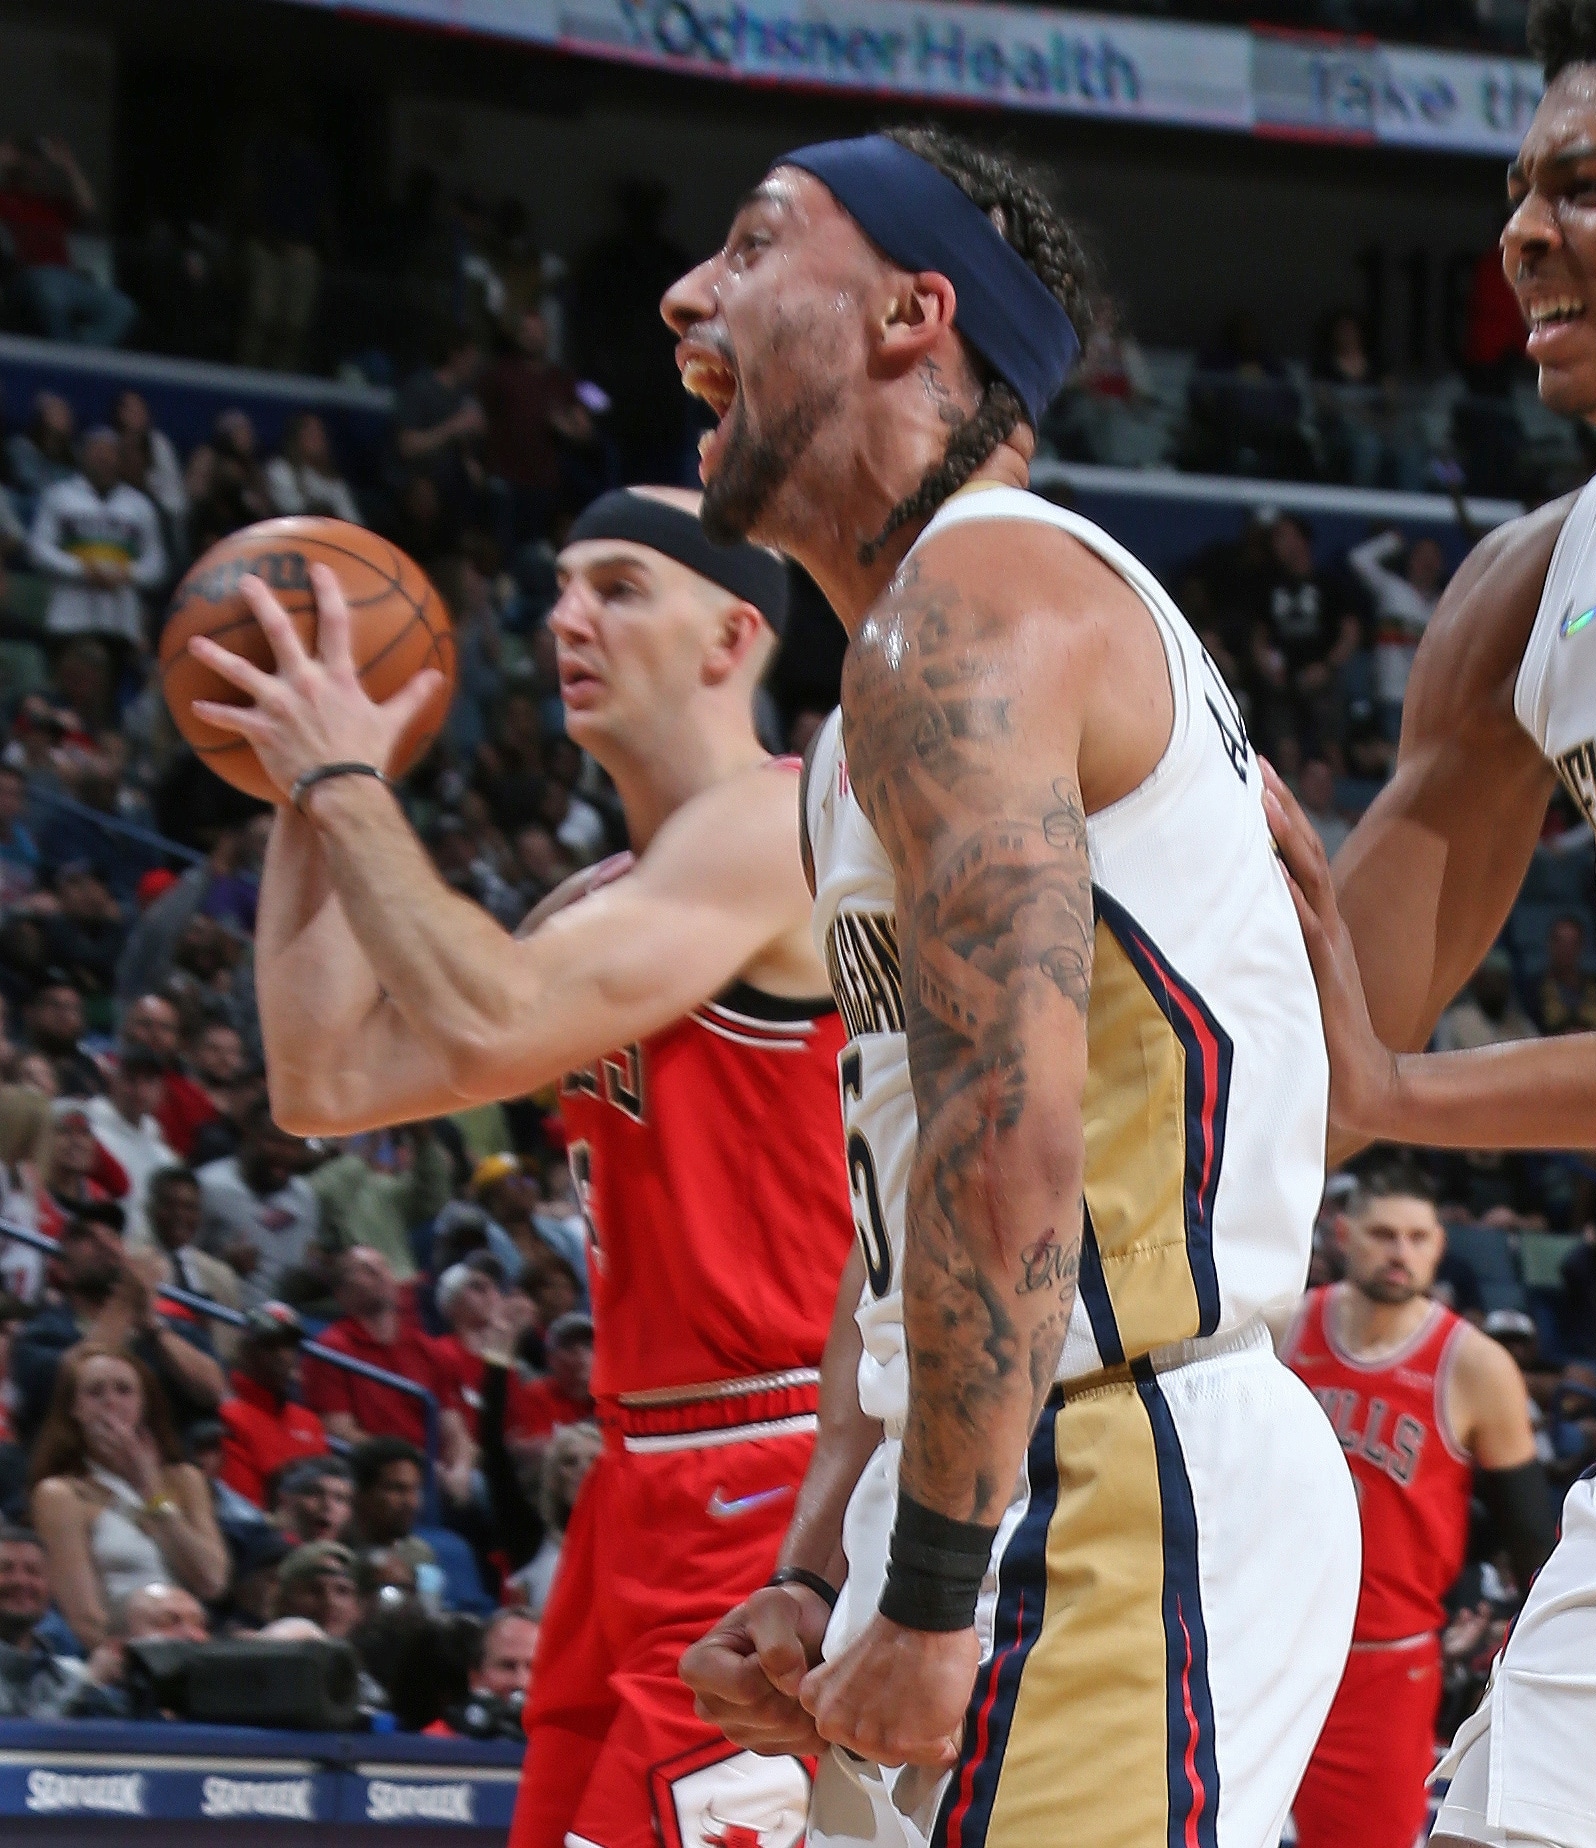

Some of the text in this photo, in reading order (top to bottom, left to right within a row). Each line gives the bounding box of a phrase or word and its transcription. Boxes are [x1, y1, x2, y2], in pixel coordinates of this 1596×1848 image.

[912, 13, 1141, 101] Health
[1306, 57, 1459, 126] Take
[1312, 1386, 1427, 1488] LLS
